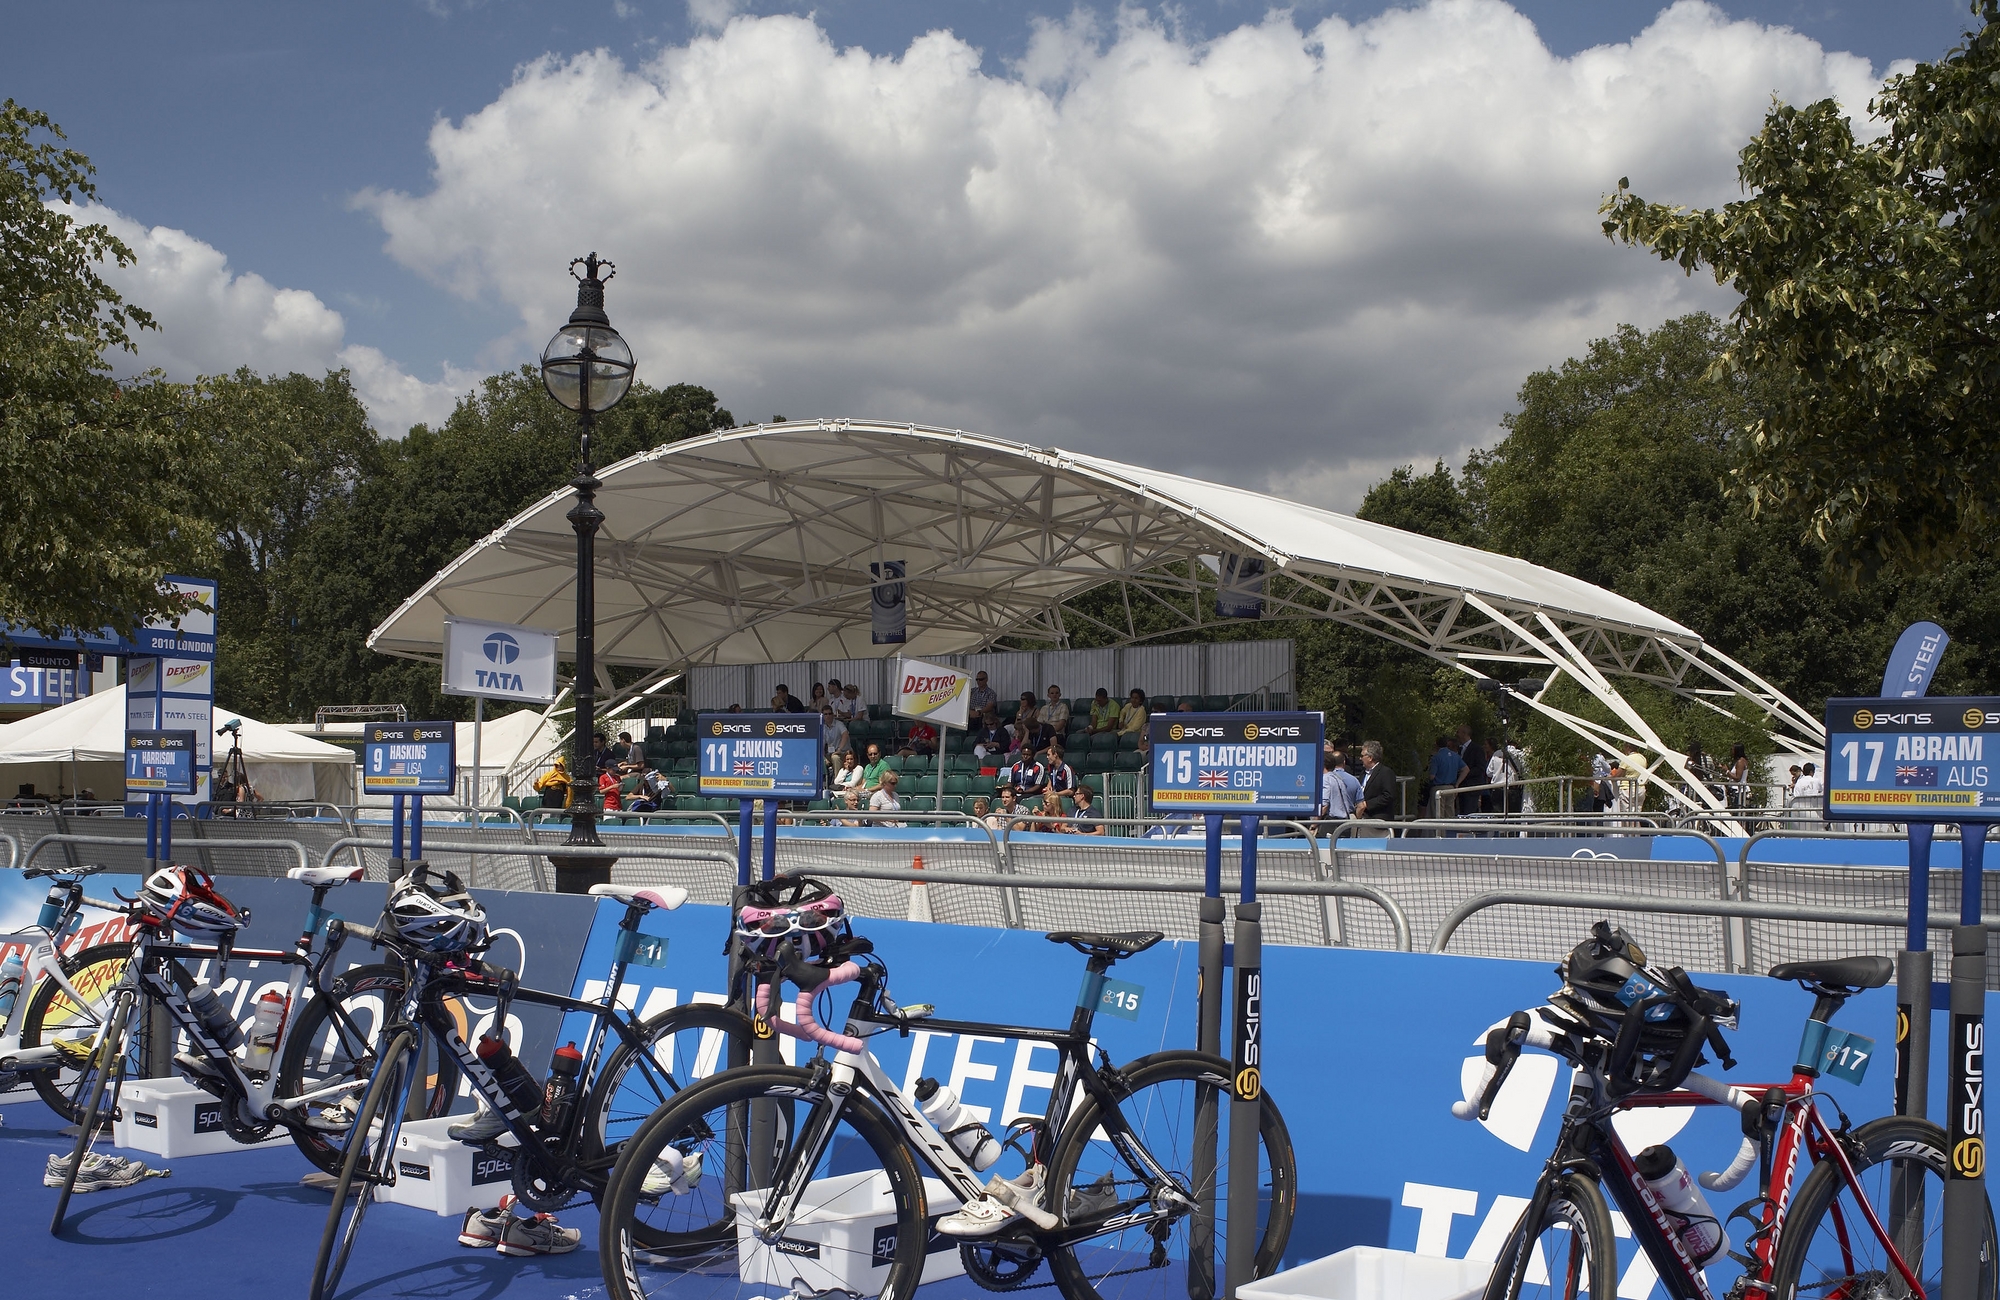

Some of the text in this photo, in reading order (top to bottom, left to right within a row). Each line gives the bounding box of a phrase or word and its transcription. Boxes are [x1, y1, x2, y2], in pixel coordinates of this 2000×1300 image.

[152, 637, 213, 653] 2010 LONDON
[28, 657, 71, 666] SUUNTO
[1908, 633, 1942, 684] STEEL
[166, 664, 201, 677] DEXTRO
[10, 666, 86, 698] STEEL
[475, 669, 524, 692] TATA
[903, 674, 956, 694] DEXTRO
[928, 688, 956, 705] ENERGY
[130, 711, 142, 719] TATA
[165, 712, 208, 721] TATA STEEL
[1874, 713, 1932, 725] SKINS
[723, 724, 805, 733] SKINS SKINS
[1184, 726, 1301, 737] SKINS SKINS
[131, 752, 175, 775] 7 HARRISON
[373, 745, 426, 772] 9 HASKINS
[706, 741, 783, 772] 11 JENKINS
[1161, 746, 1297, 783] 15 BLATCHFORD
[1840, 736, 1983, 782] 17 ABRAM
[156, 767, 167, 777] FRA
[407, 763, 422, 774] USA
[758, 761, 778, 775] GBR
[1946, 766, 1988, 787] AUS
[1234, 771, 1262, 787] GBR
[1157, 792, 1249, 801] DEXTRO ENERGY TRIATHLON
[1834, 793, 1970, 803] DEXTRO ENERGY TRIATHLON
[200, 907, 226, 920] RUDY
[647, 943, 662, 961] 11
[45, 959, 123, 1014] ENERG
[353, 977, 405, 993] ZIP
[603, 961, 620, 1000] GIANT
[404, 965, 430, 1021] GINT
[1116, 990, 1139, 1011] 15
[1245, 974, 1260, 1066] SKINS
[1839, 1046, 1868, 1071] 17
[446, 1028, 521, 1121] GIANT
[1964, 1022, 1984, 1135] SKINS
[135, 1090, 140, 1098] 7
[764, 1085, 827, 1104] ZIP
[402, 1136, 408, 1146] 9
[1882, 1140, 1947, 1170] ZIP
[401, 1165, 420, 1175] speedo
[778, 1241, 805, 1253] speedo
